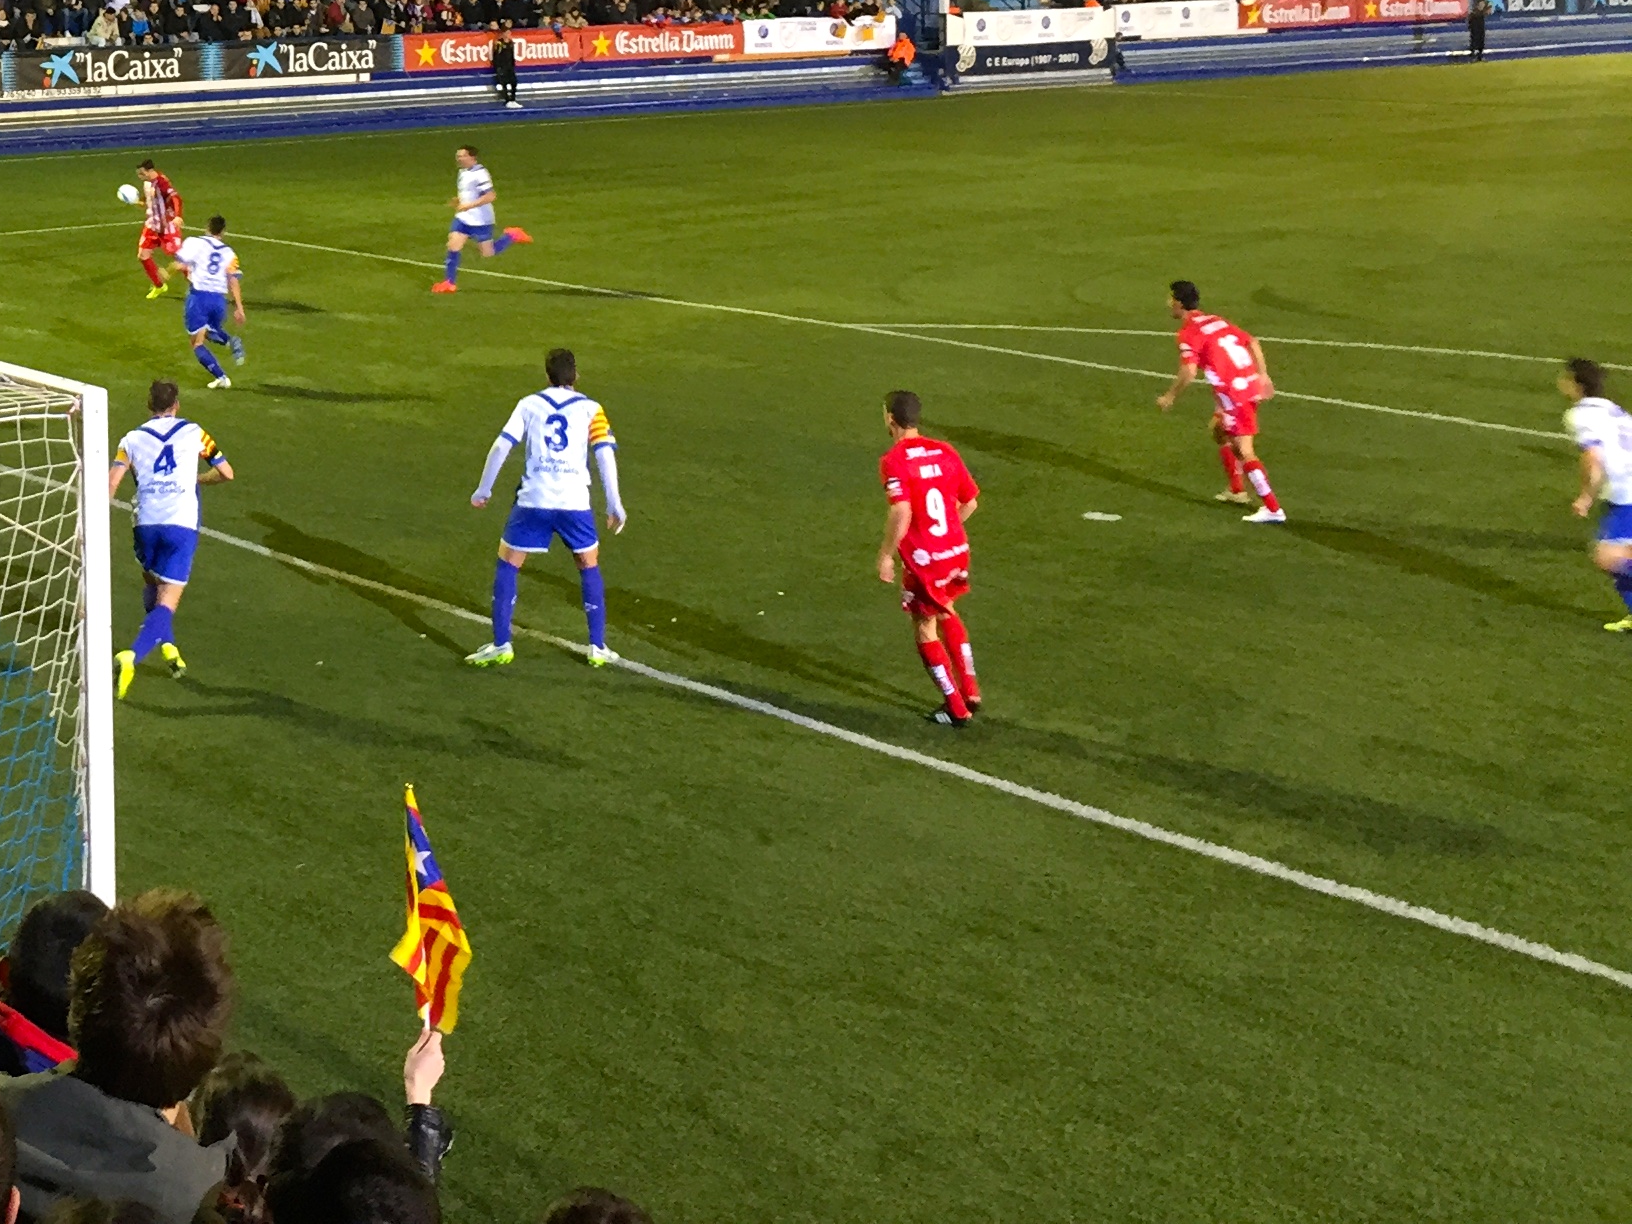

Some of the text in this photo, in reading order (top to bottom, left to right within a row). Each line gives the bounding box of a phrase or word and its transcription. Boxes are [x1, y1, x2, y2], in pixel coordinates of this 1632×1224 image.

[440, 37, 570, 64] Estrel Damm
[615, 30, 735, 54] Estrella Damm
[986, 57, 993, 67] C
[994, 57, 1000, 67] E
[207, 251, 222, 275] 8
[544, 413, 568, 452] 3
[153, 444, 177, 476] 4
[926, 487, 948, 537] 9
